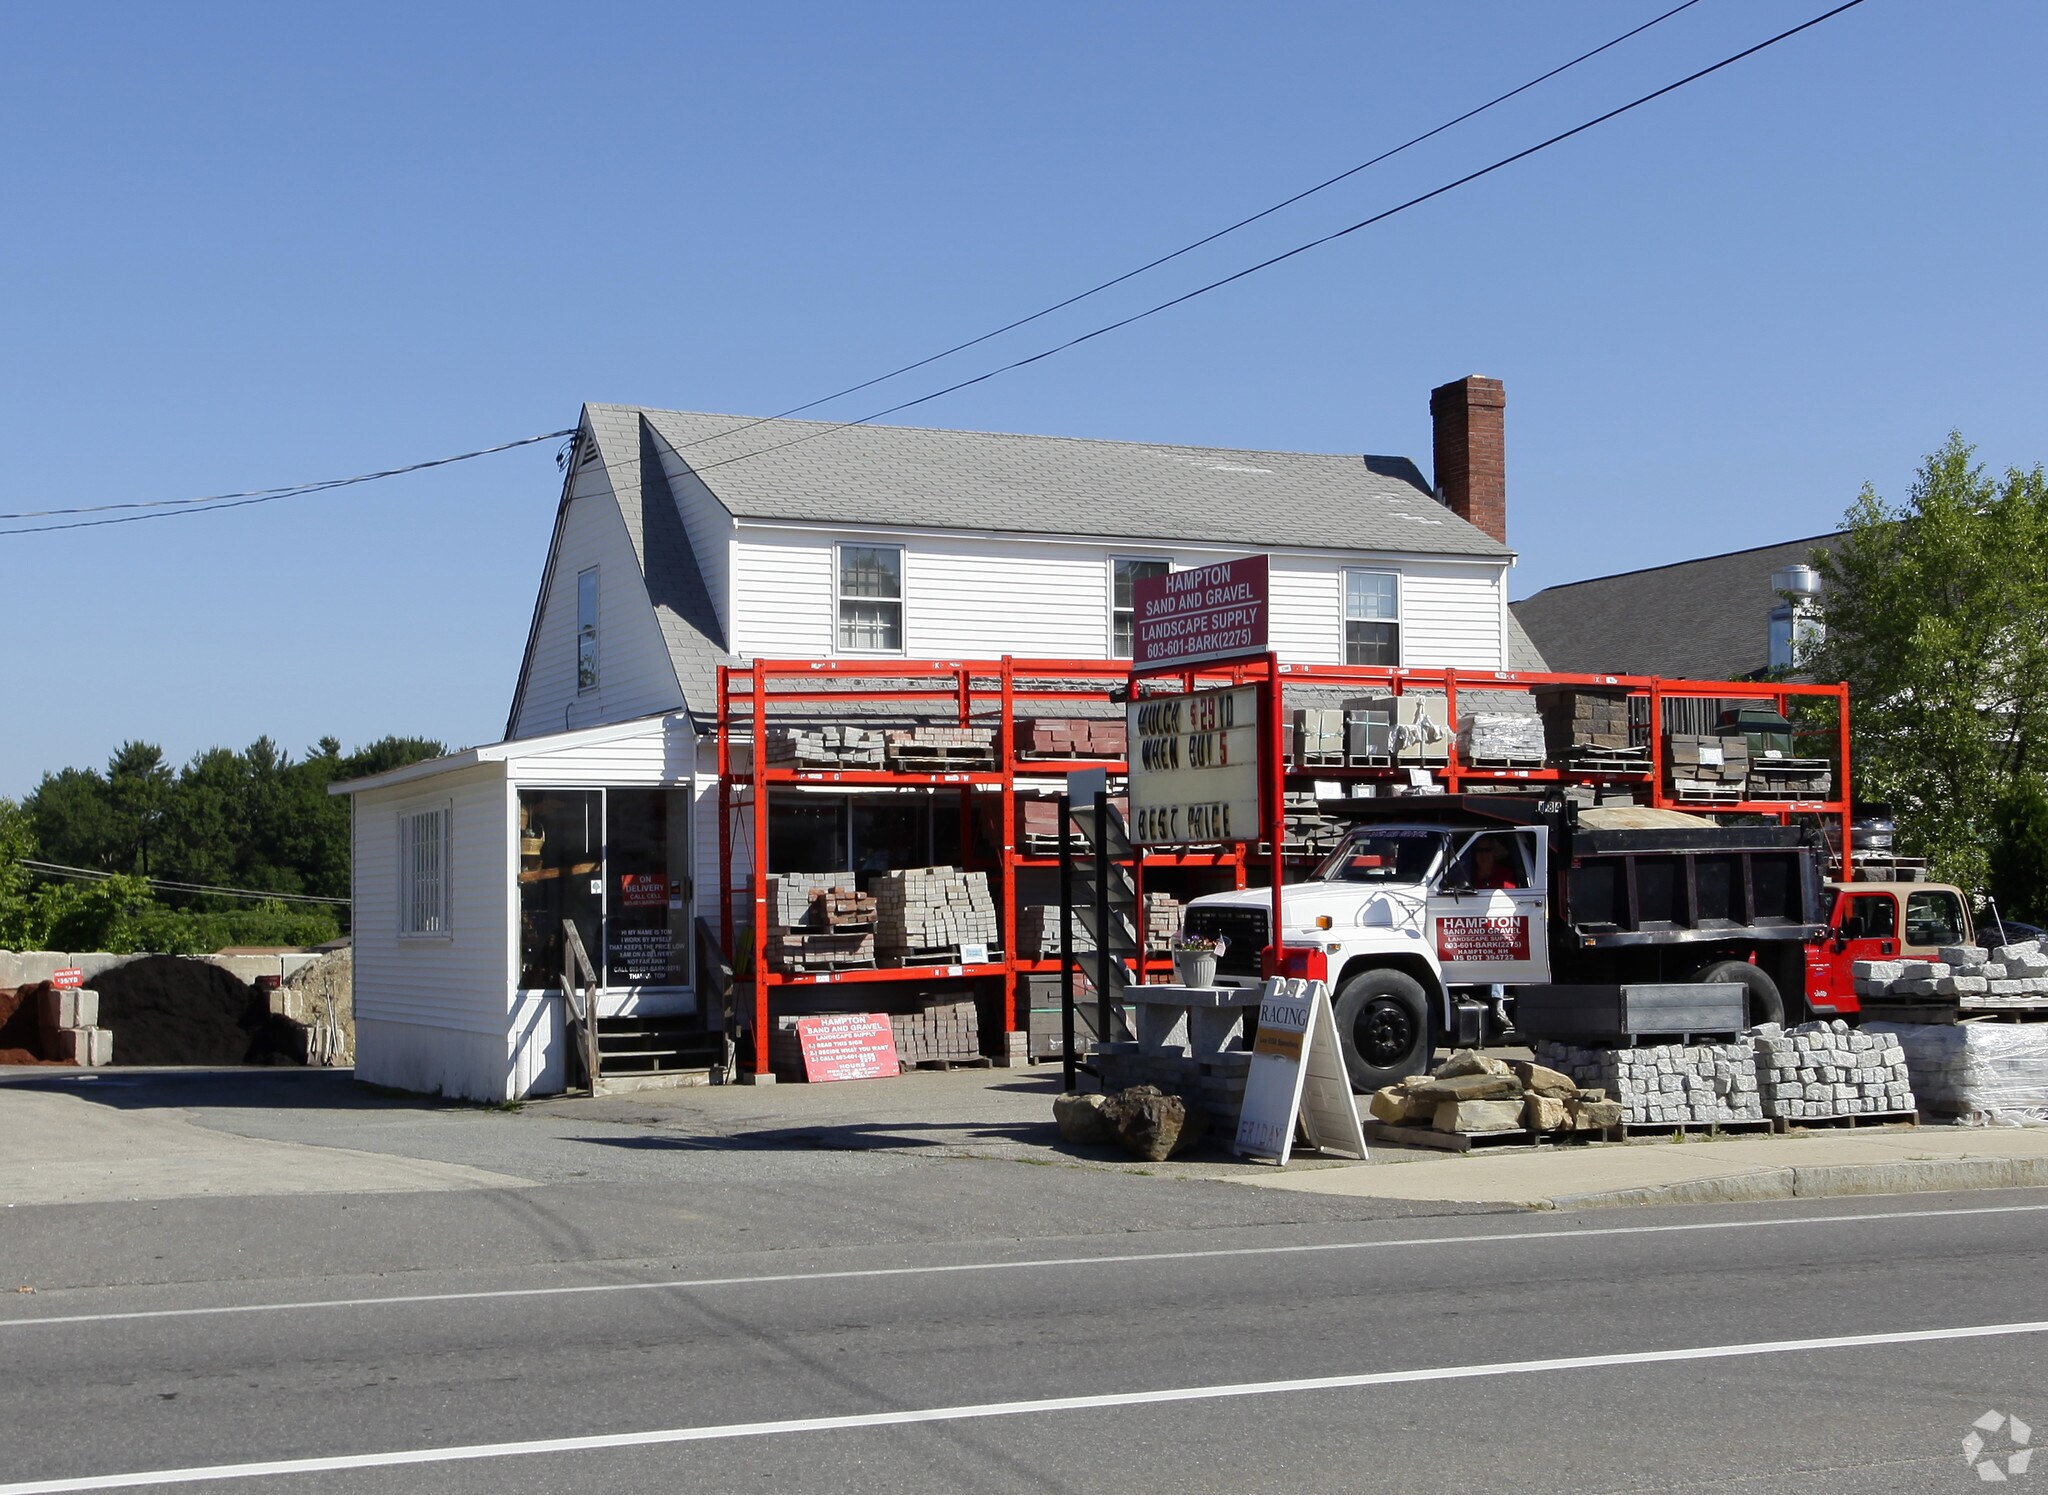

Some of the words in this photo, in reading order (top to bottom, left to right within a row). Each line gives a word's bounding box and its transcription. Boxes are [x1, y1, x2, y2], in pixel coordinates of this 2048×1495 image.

[1166, 565, 1231, 593] HAMPTON
[1146, 597, 1175, 616] SAND
[1179, 592, 1201, 610] AND
[1206, 583, 1253, 605] GRAVEL
[1142, 616, 1207, 641] LANDSCAPE
[1212, 608, 1257, 630] SUPPLY
[1147, 628, 1251, 659] 603-601-BARK(2275)
[1219, 693, 1233, 727] YD
[1142, 737, 1179, 770] WHEN
[1189, 732, 1212, 767] BUY
[1220, 731, 1227, 765] 5
[1138, 808, 1178, 840] BEST
[1188, 803, 1231, 838] PRICE
[626, 884, 664, 893] DELIVERY
[1443, 917, 1521, 929] HAMPTON
[821, 1017, 866, 1026] HAMPTON
[851, 1023, 883, 1031] GRAVEL
[1261, 1004, 1307, 1026] RACING
[816, 1033, 853, 1041] LANDSCAPE
[1239, 1120, 1283, 1149] FRIDAY
